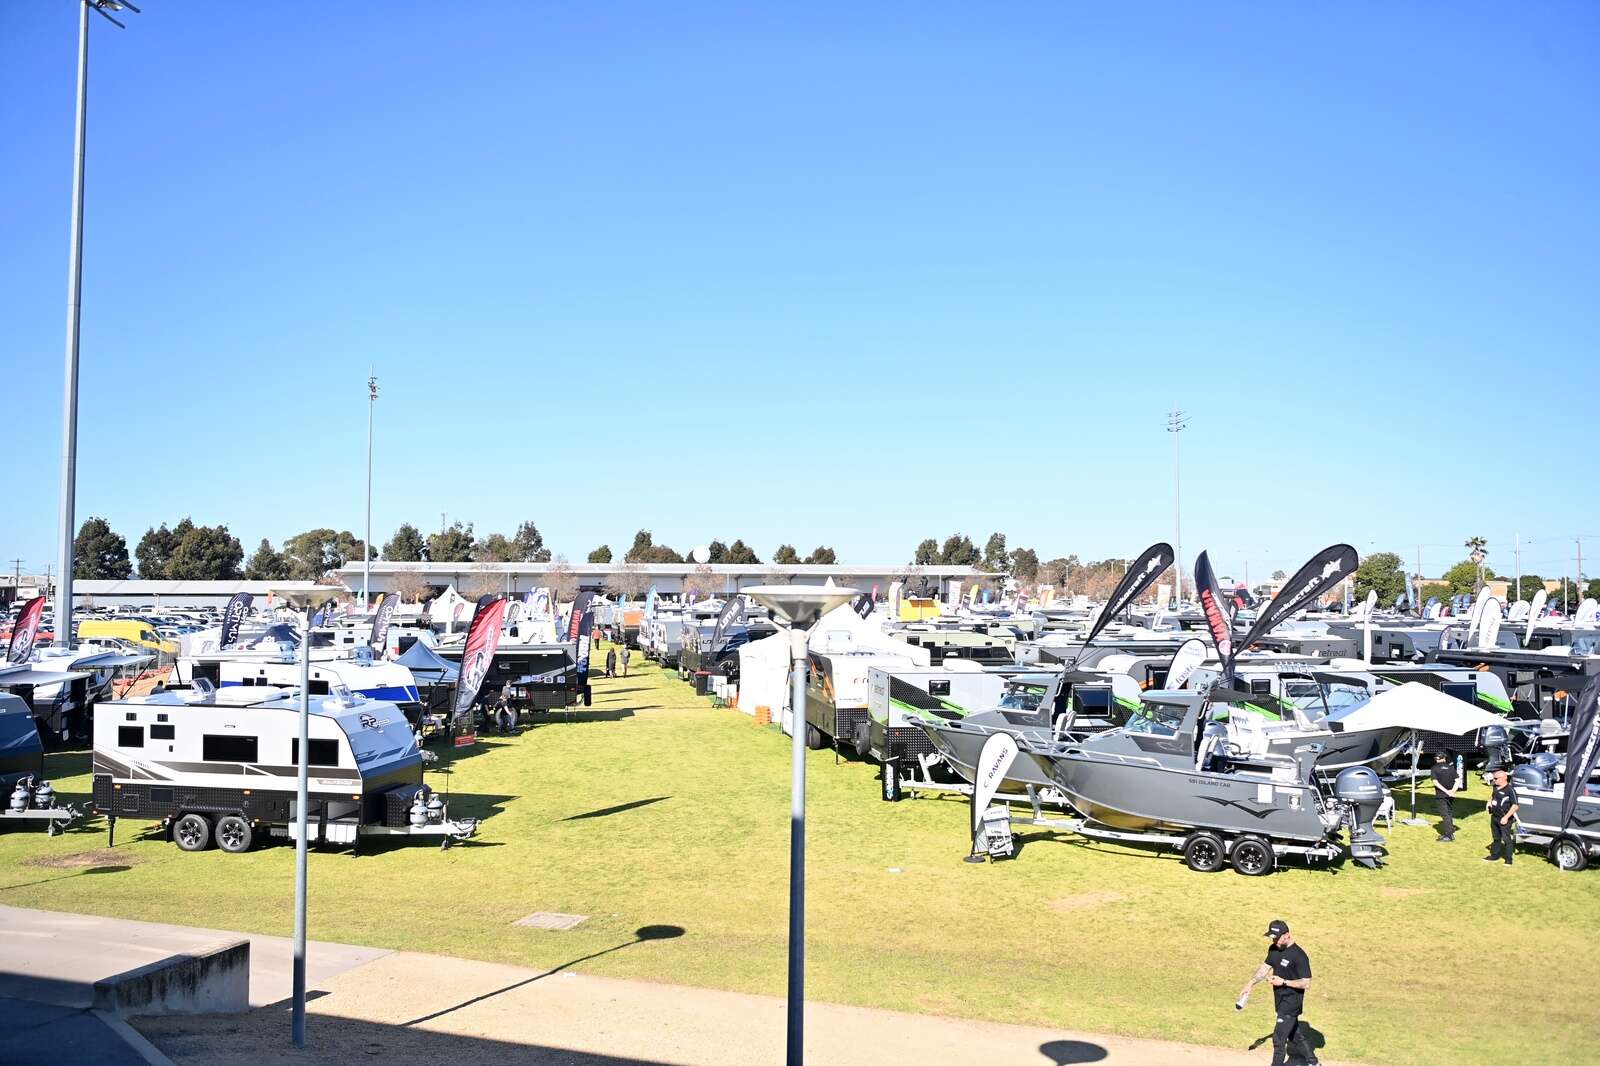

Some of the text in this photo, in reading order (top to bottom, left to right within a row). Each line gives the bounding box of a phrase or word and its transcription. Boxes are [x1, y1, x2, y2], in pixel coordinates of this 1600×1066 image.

[1270, 576, 1321, 622] makocraft
[569, 608, 581, 639] YAMAHA
[719, 601, 741, 630] LOTUS
